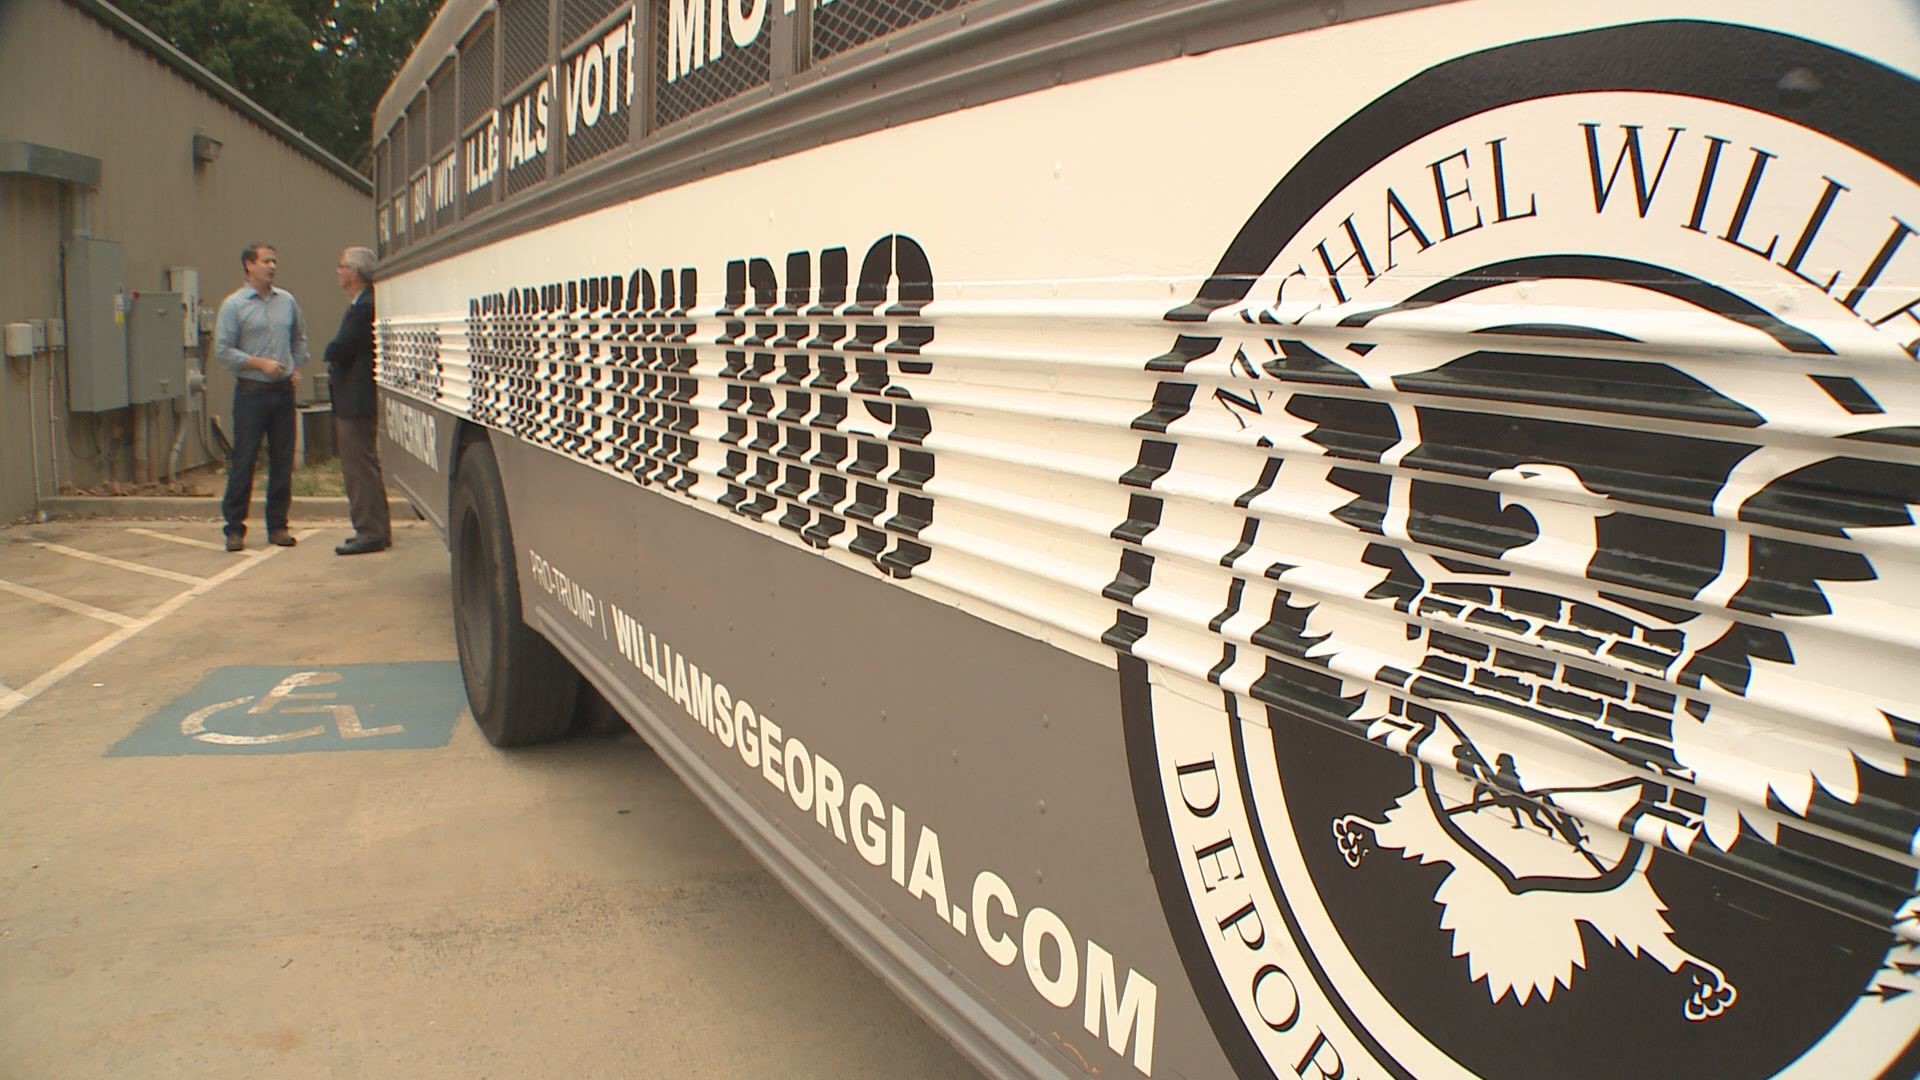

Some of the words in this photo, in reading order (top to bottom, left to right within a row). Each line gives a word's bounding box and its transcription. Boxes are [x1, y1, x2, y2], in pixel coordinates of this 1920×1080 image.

[714, 233, 934, 580] BUS
[530, 549, 596, 628] PRO-TRUMP
[611, 603, 1157, 1078] WILLIAMSGEORGIA.COM
